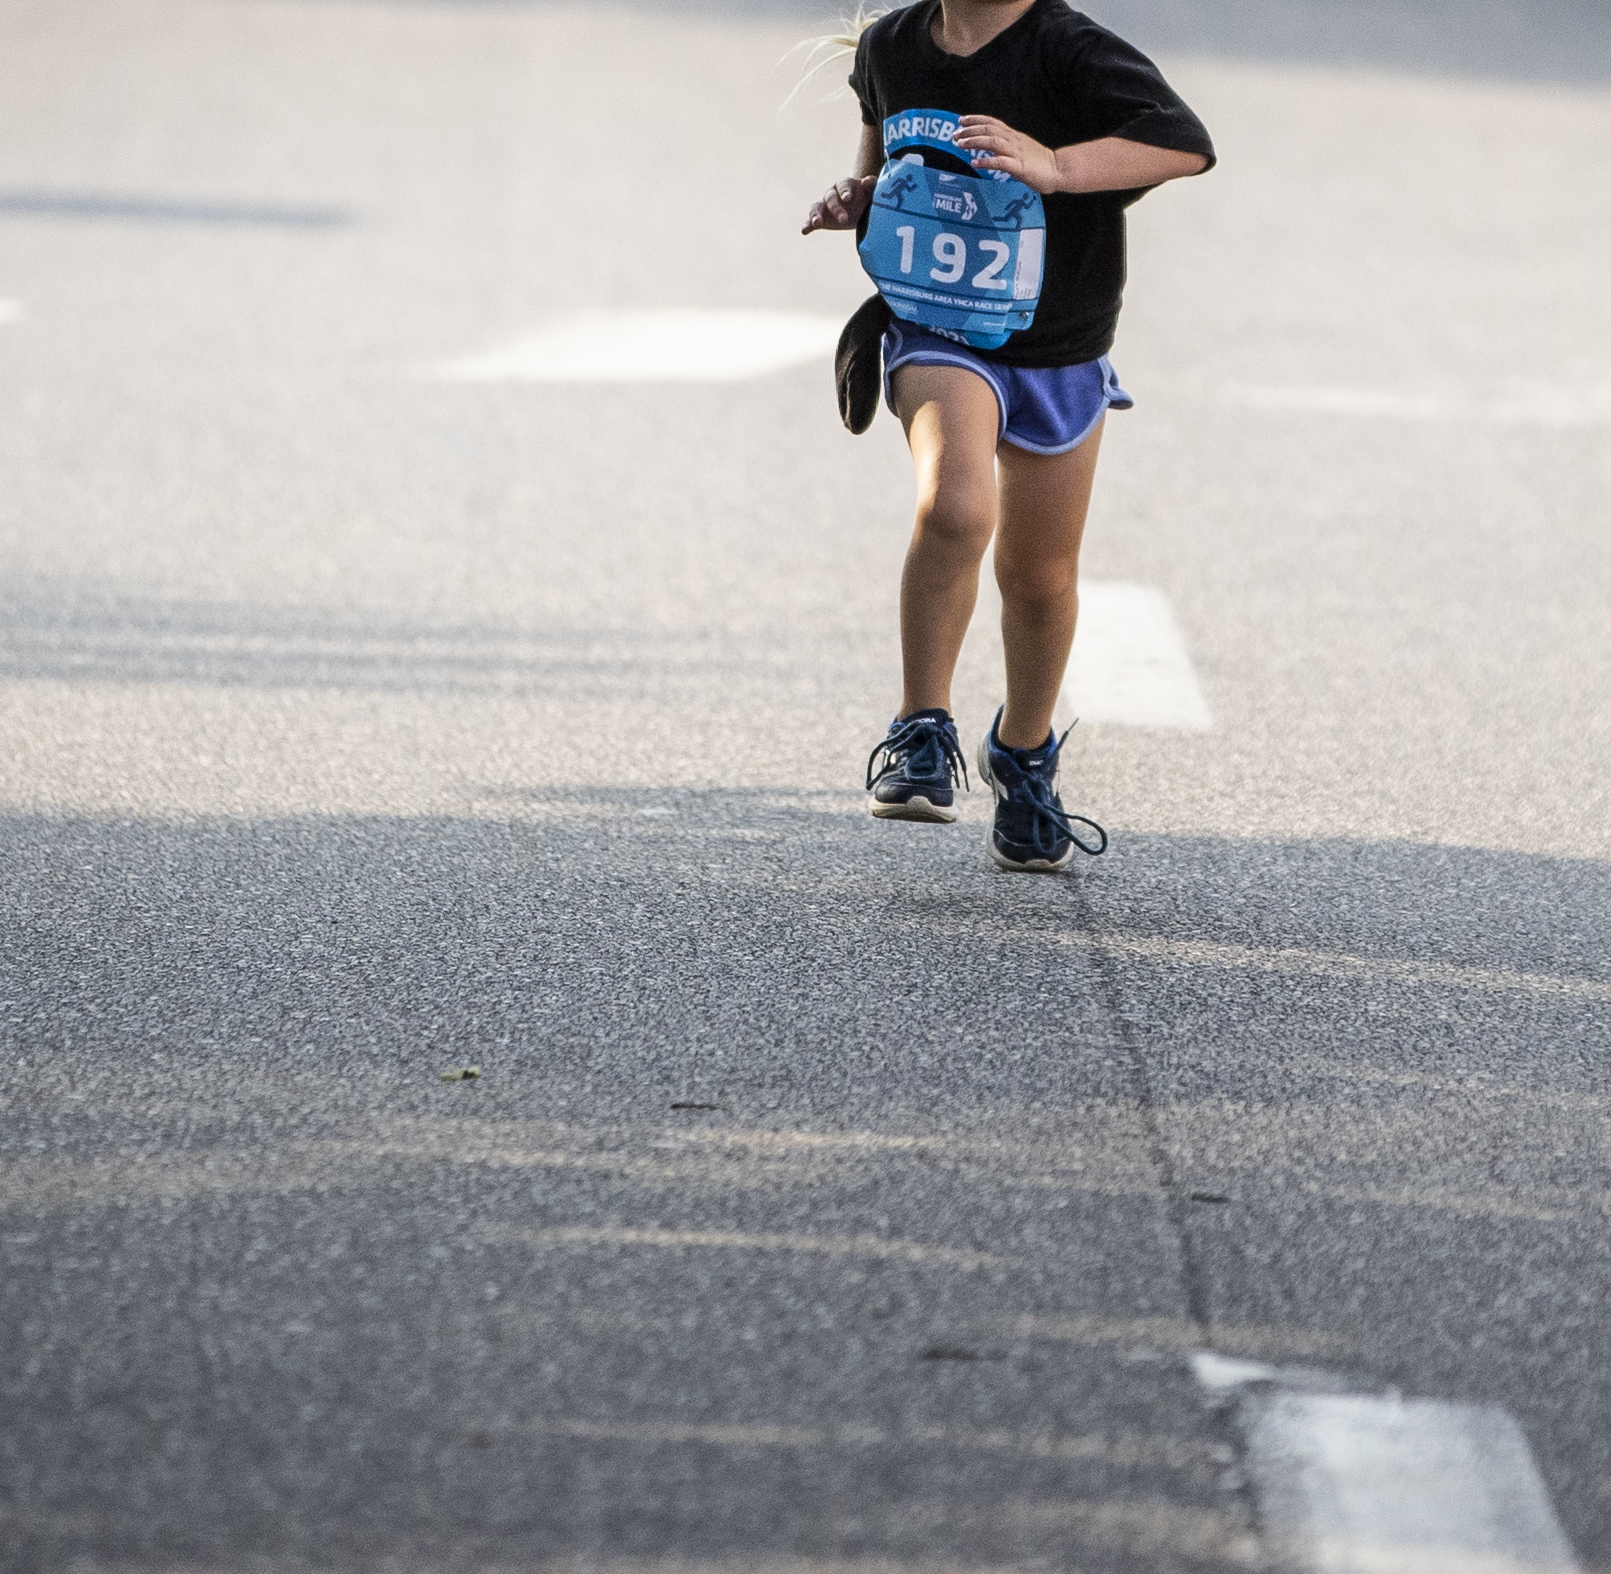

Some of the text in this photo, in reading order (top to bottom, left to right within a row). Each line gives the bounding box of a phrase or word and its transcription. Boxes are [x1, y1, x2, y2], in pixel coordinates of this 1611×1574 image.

[935, 198, 962, 214] MILE
[896, 225, 1010, 290] 192
[953, 297, 974, 307] YMCA
[974, 301, 993, 310] RACE
